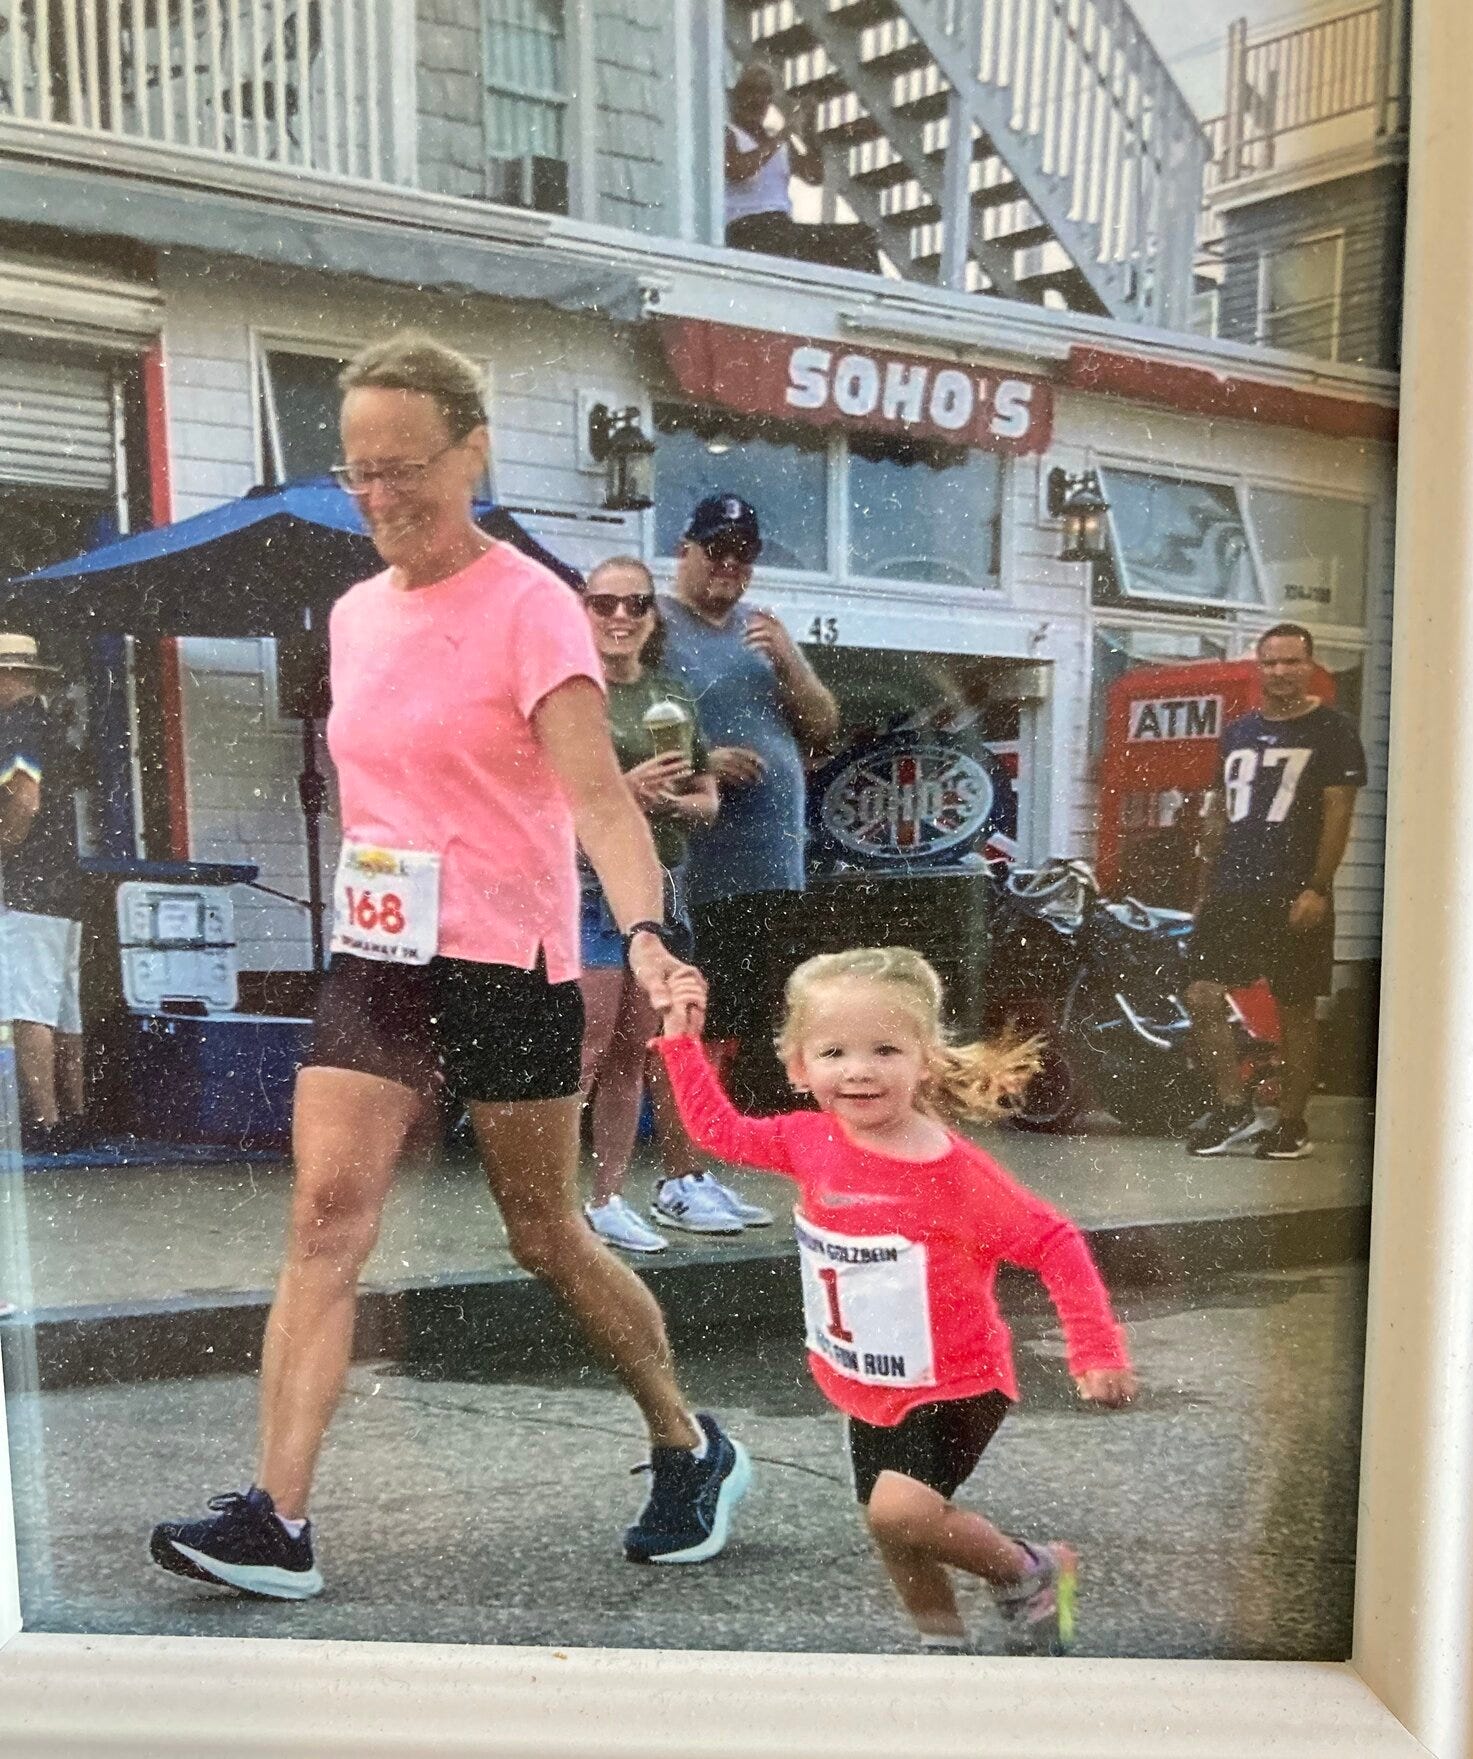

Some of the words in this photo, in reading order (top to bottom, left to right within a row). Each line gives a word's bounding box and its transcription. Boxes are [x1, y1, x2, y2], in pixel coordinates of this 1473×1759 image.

[785, 346, 1033, 439] SOHO'S
[1132, 699, 1218, 739] ATM
[1224, 747, 1313, 823] 87
[345, 886, 406, 934] 168
[818, 1267, 854, 1343] 1
[864, 1352, 905, 1377] RUN
